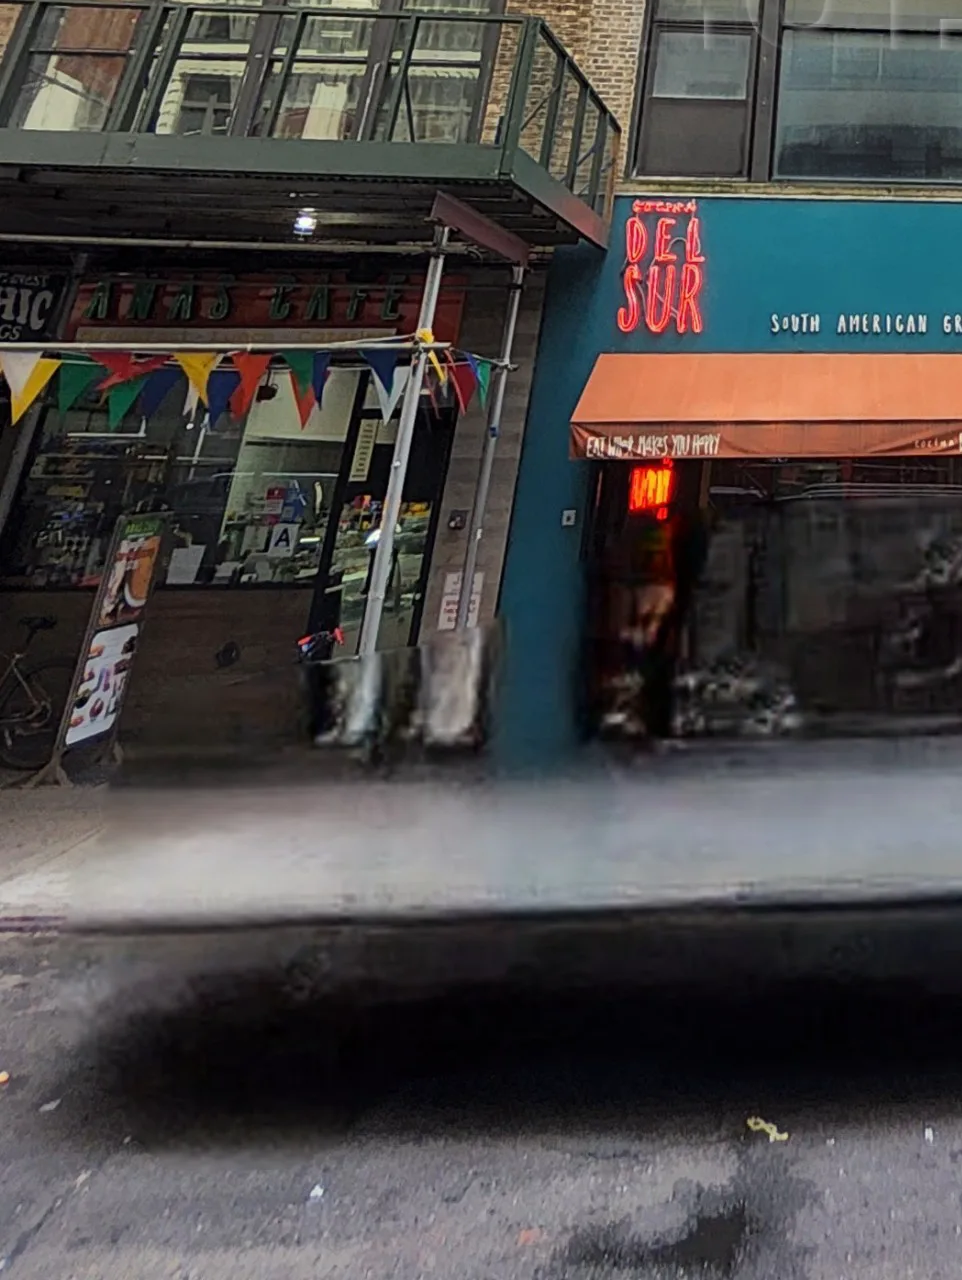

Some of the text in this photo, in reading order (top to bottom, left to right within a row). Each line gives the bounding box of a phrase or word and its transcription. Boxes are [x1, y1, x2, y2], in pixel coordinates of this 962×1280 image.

[626, 217, 705, 263] DEL
[268, 275, 408, 321] CAFE
[617, 264, 703, 333] SUR
[771, 313, 820, 333] SOUTH
[837, 314, 927, 333] AMERICAN
[672, 434, 690, 457] YOU
[274, 527, 291, 548] A
